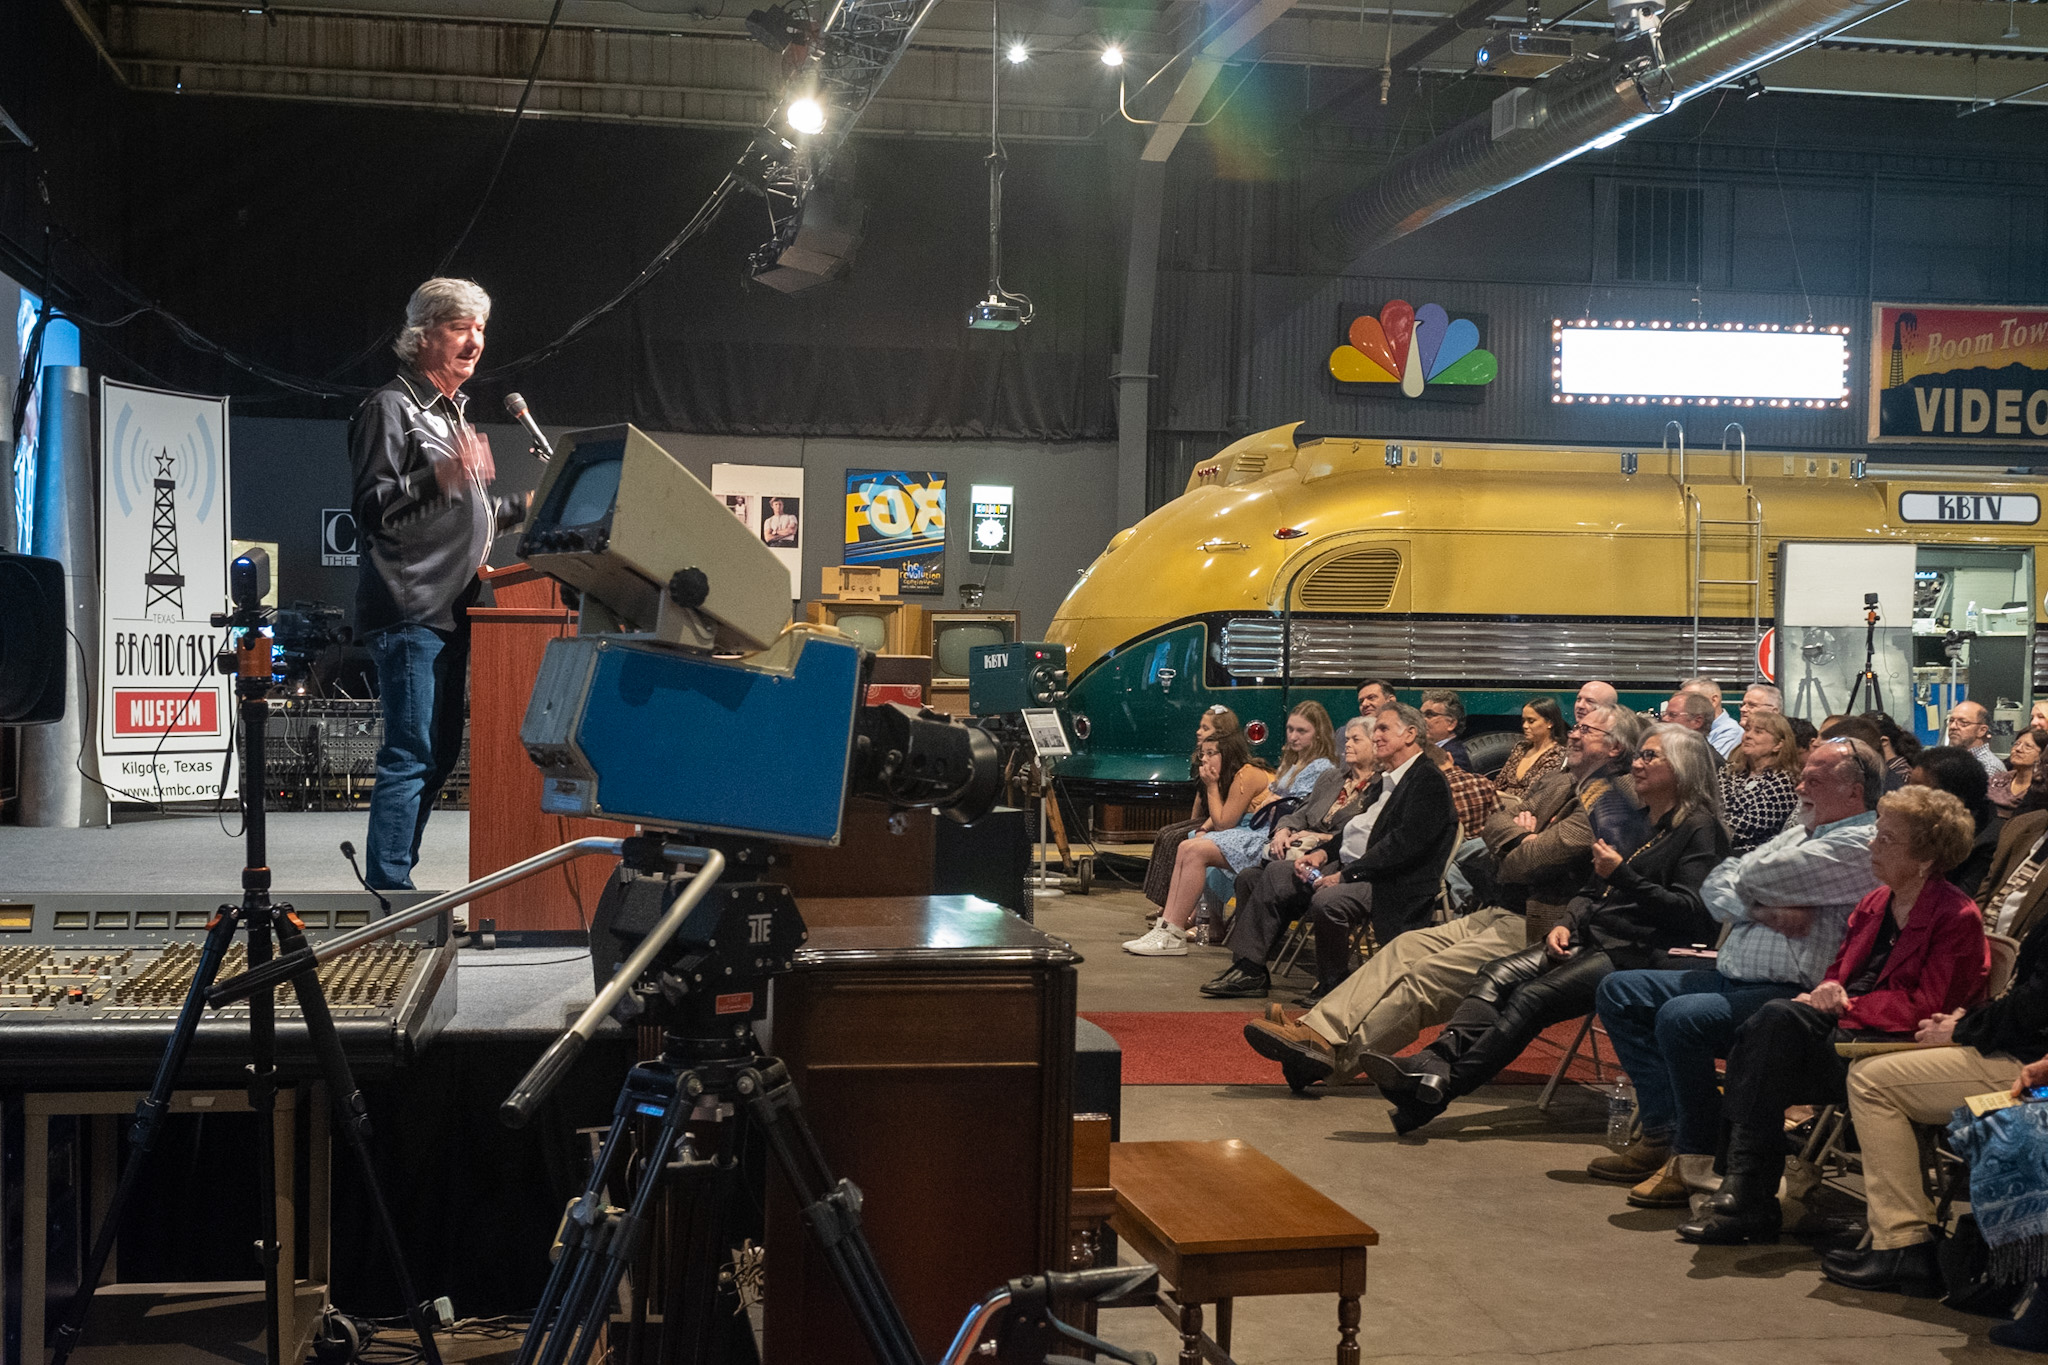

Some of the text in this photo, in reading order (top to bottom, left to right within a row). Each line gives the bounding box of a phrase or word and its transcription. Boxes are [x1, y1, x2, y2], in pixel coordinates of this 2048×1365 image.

[1924, 317, 2048, 365] Boom Tow
[1914, 387, 2048, 436] VIDEO
[845, 480, 946, 544] FOX
[1938, 495, 2002, 520] KBTV
[325, 555, 352, 566] THE
[902, 560, 920, 571] the
[153, 613, 176, 624] TEXAS
[115, 632, 216, 676] BROADCAST
[984, 653, 1009, 669] KBTV
[130, 699, 201, 727] MUSEUM
[122, 760, 213, 777] Kilgore, Texas
[120, 783, 220, 797] www.txmbc.org
